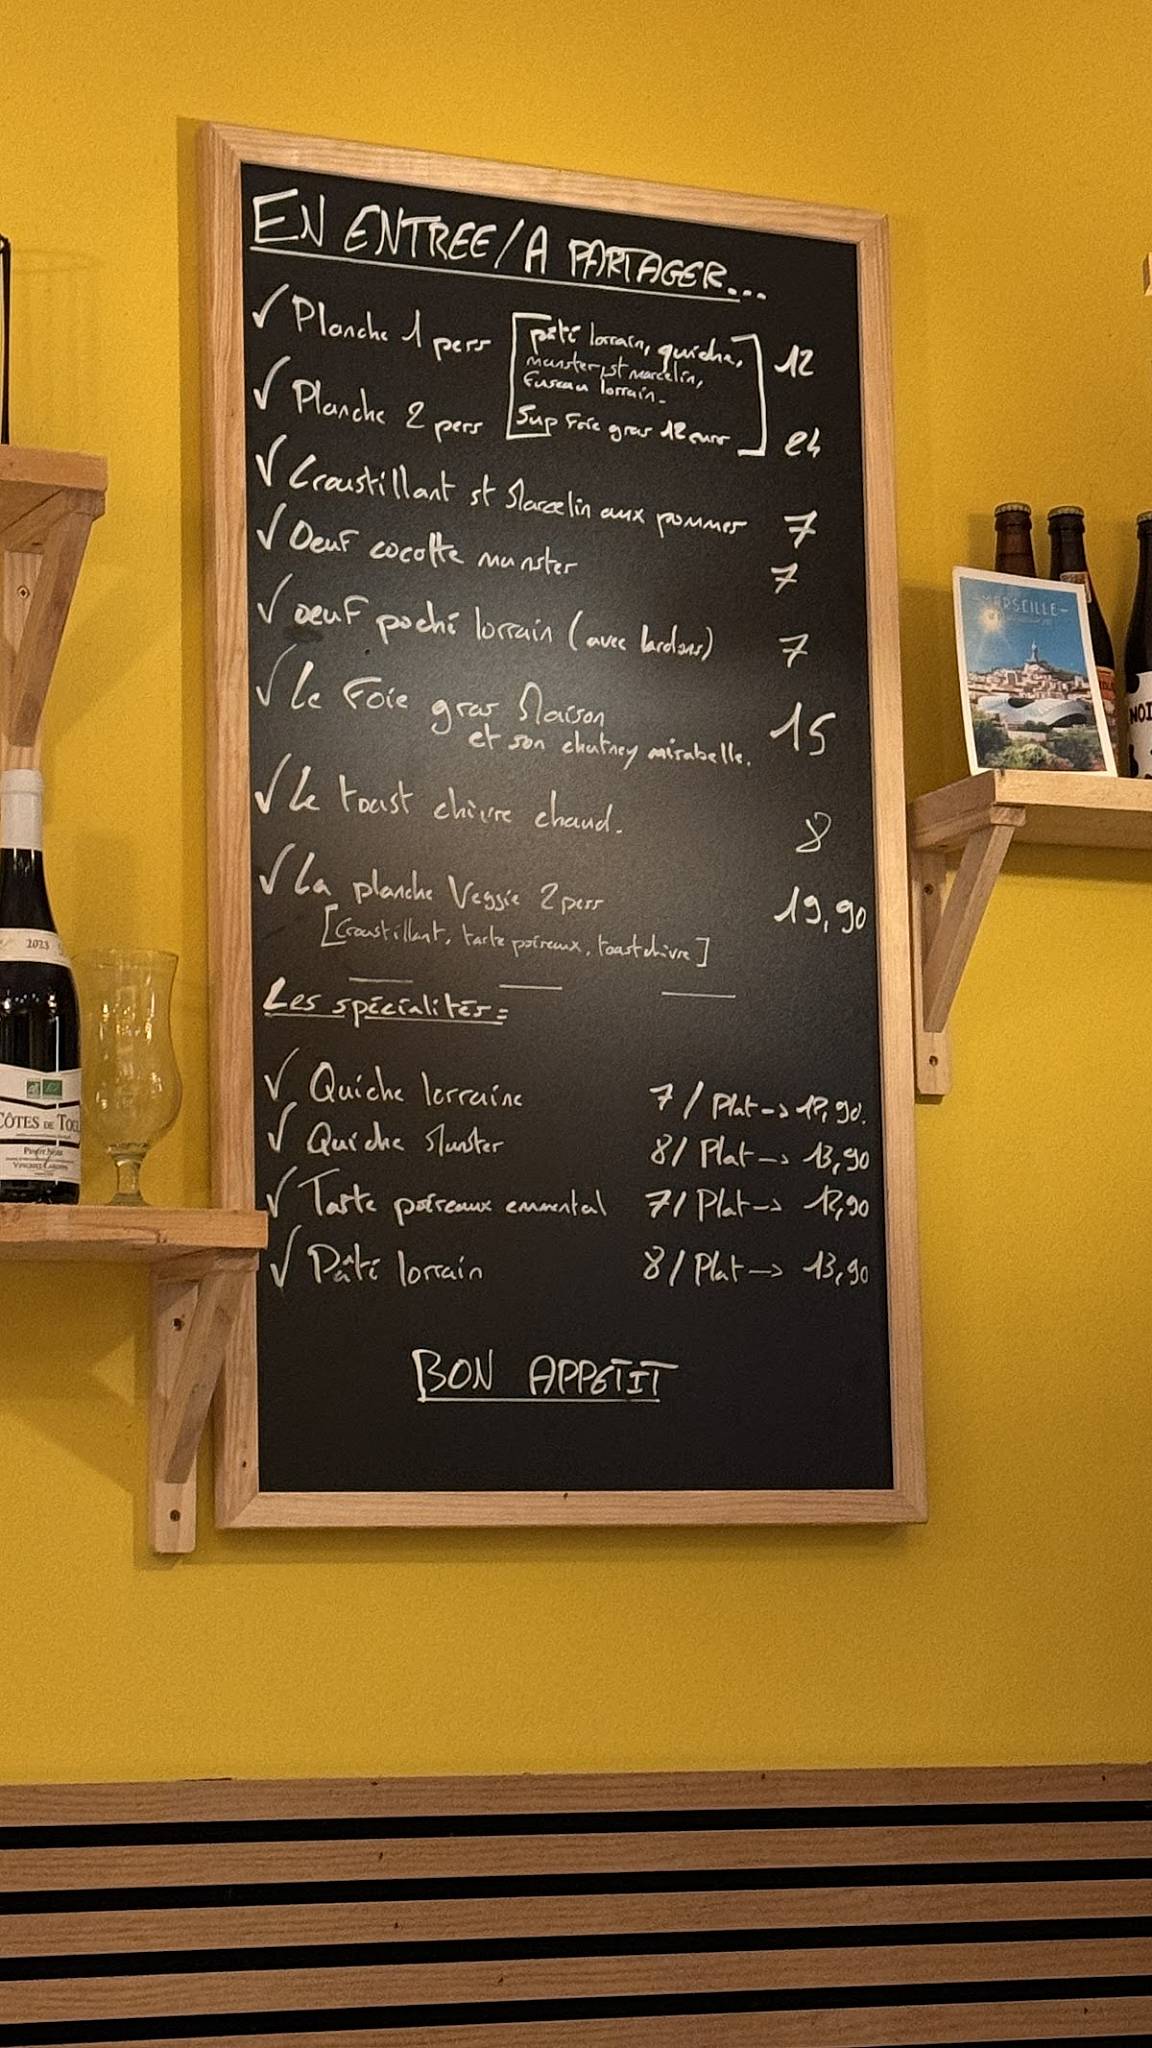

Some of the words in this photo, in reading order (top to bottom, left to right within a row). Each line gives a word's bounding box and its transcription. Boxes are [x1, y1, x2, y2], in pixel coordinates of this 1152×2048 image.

[252, 188, 326, 248] EN
[291, 294, 389, 342] Planche
[401, 309, 422, 348] 1
[432, 336, 493, 362] pers
[590, 321, 651, 356] lorrain,
[658, 338, 744, 374] quiche,
[628, 361, 704, 390] marcelin,
[773, 344, 815, 378] 12
[291, 379, 387, 426] Planche
[406, 401, 425, 430] 2
[434, 419, 484, 444] pers
[516, 404, 559, 436] Sup
[608, 424, 653, 442] gras
[660, 420, 687, 441] 12
[784, 427, 822, 459] 24
[288, 454, 457, 501] Croustillant
[469, 474, 497, 507] st
[600, 507, 646, 524] aux
[656, 511, 748, 539] pommes
[783, 509, 819, 550] 7
[369, 531, 465, 568] cocotte
[477, 546, 578, 576] munster
[770, 562, 799, 595] 7
[375, 600, 460, 645] poché
[475, 605, 553, 643] lorrain
[568, 610, 627, 652] (avec
[778, 632, 810, 669] 7
[290, 660, 323, 710] Le
[431, 699, 500, 736] gras
[468, 722, 502, 751] et
[507, 735, 546, 751] son
[561, 730, 639, 771] chutney
[647, 738, 752, 768] mirabelle.
[769, 701, 838, 757] 15
[288, 765, 321, 813] Le
[338, 773, 414, 815] toast
[534, 789, 624, 835] chaud.
[795, 811, 833, 854] 8
[293, 852, 332, 897] La
[352, 868, 433, 905] planche
[447, 874, 520, 912] Veggie
[540, 883, 560, 911] 2
[773, 885, 868, 935] 19,90
[462, 924, 505, 948] tarte
[262, 976, 323, 1012] Les
[308, 1060, 406, 1104] Quiche
[420, 1070, 524, 1108] lorraine
[711, 1093, 759, 1120] Plat
[306, 1120, 406, 1157] Quiche
[700, 1135, 755, 1169] Plat
[802, 1141, 871, 1176] 13,90
[297, 1168, 378, 1217] Tarte
[393, 1192, 494, 1227] poireaux
[696, 1187, 751, 1223] Plat
[802, 1184, 871, 1222] 12,90
[306, 1242, 382, 1285] Pâté
[397, 1249, 484, 1287] lorrain
[694, 1249, 745, 1288] Plat
[802, 1249, 869, 1287] 13,90
[411, 1347, 494, 1397] BON
[528, 1354, 680, 1396] APPETIT
